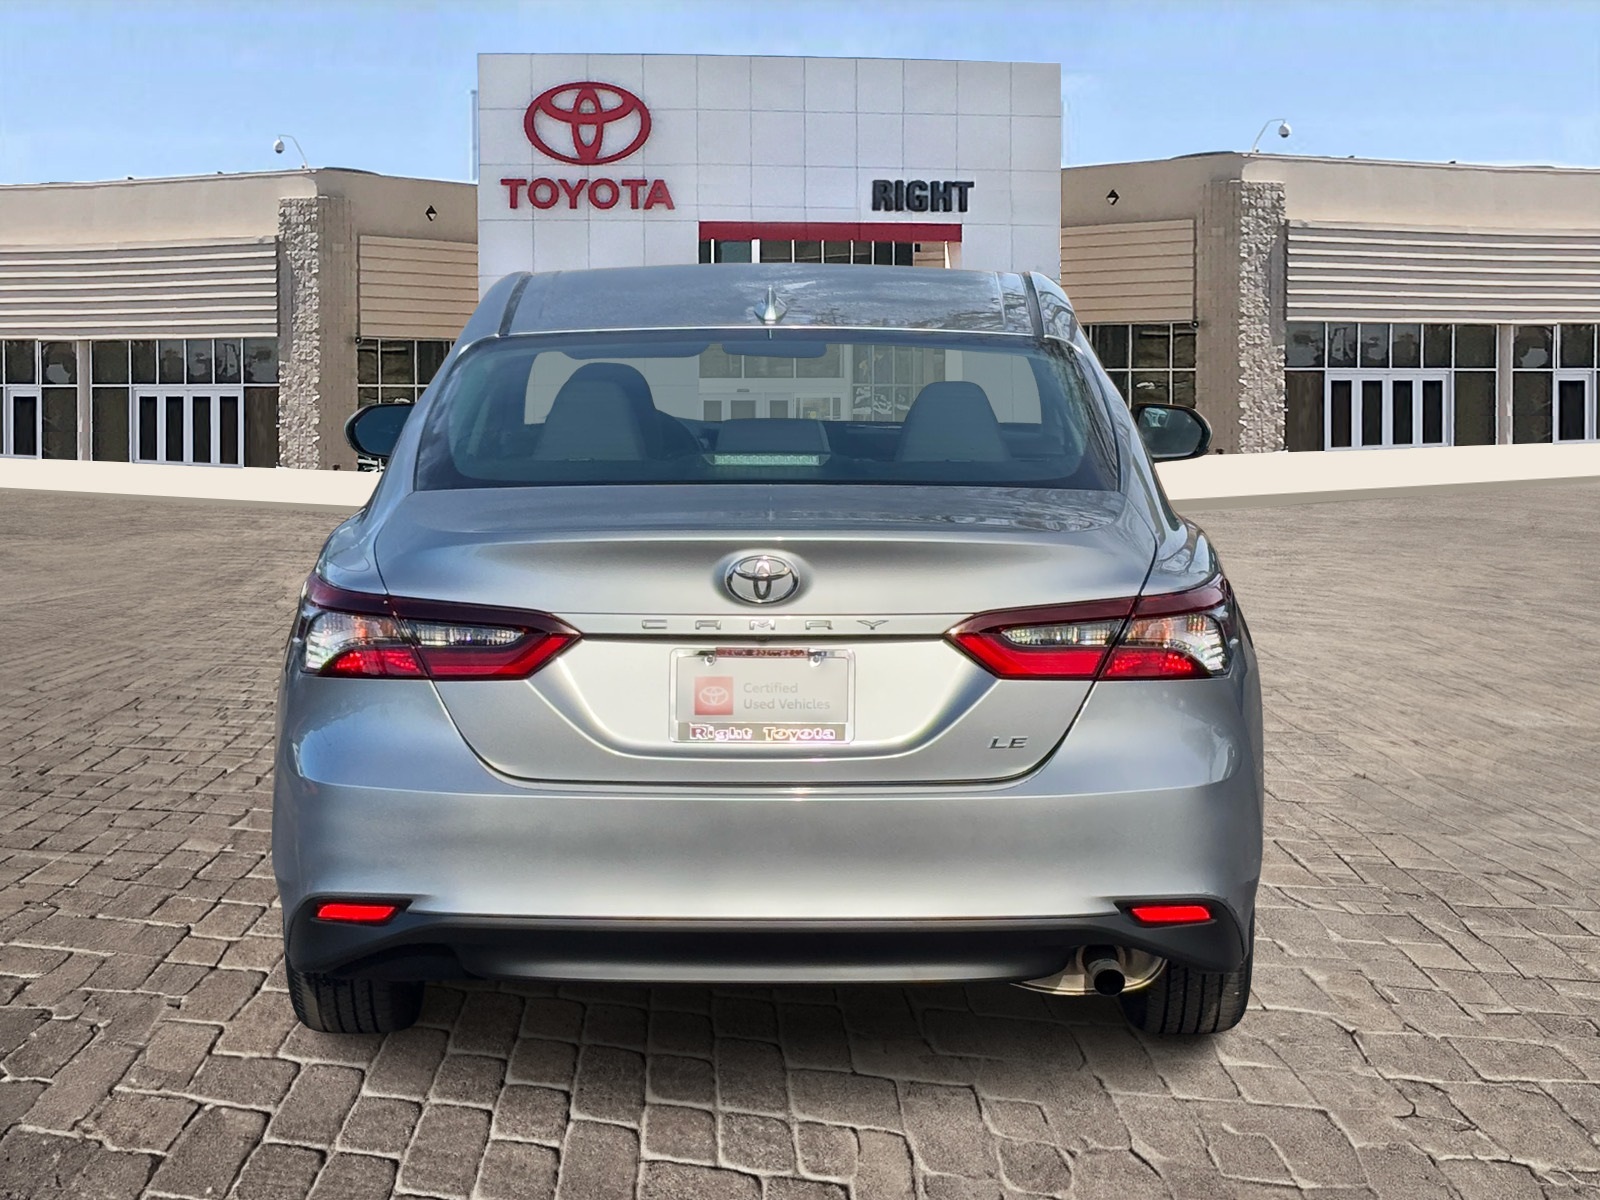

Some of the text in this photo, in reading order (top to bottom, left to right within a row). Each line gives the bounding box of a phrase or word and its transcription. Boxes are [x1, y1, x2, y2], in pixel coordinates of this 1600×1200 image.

[500, 178, 675, 209] TOYOTA
[872, 180, 974, 212] RIGHT
[641, 619, 889, 630] CAMRY
[743, 682, 799, 693] Certified
[743, 698, 831, 710] Used Vehicles
[690, 724, 836, 741] Right Toyota
[988, 736, 1028, 749] LE
